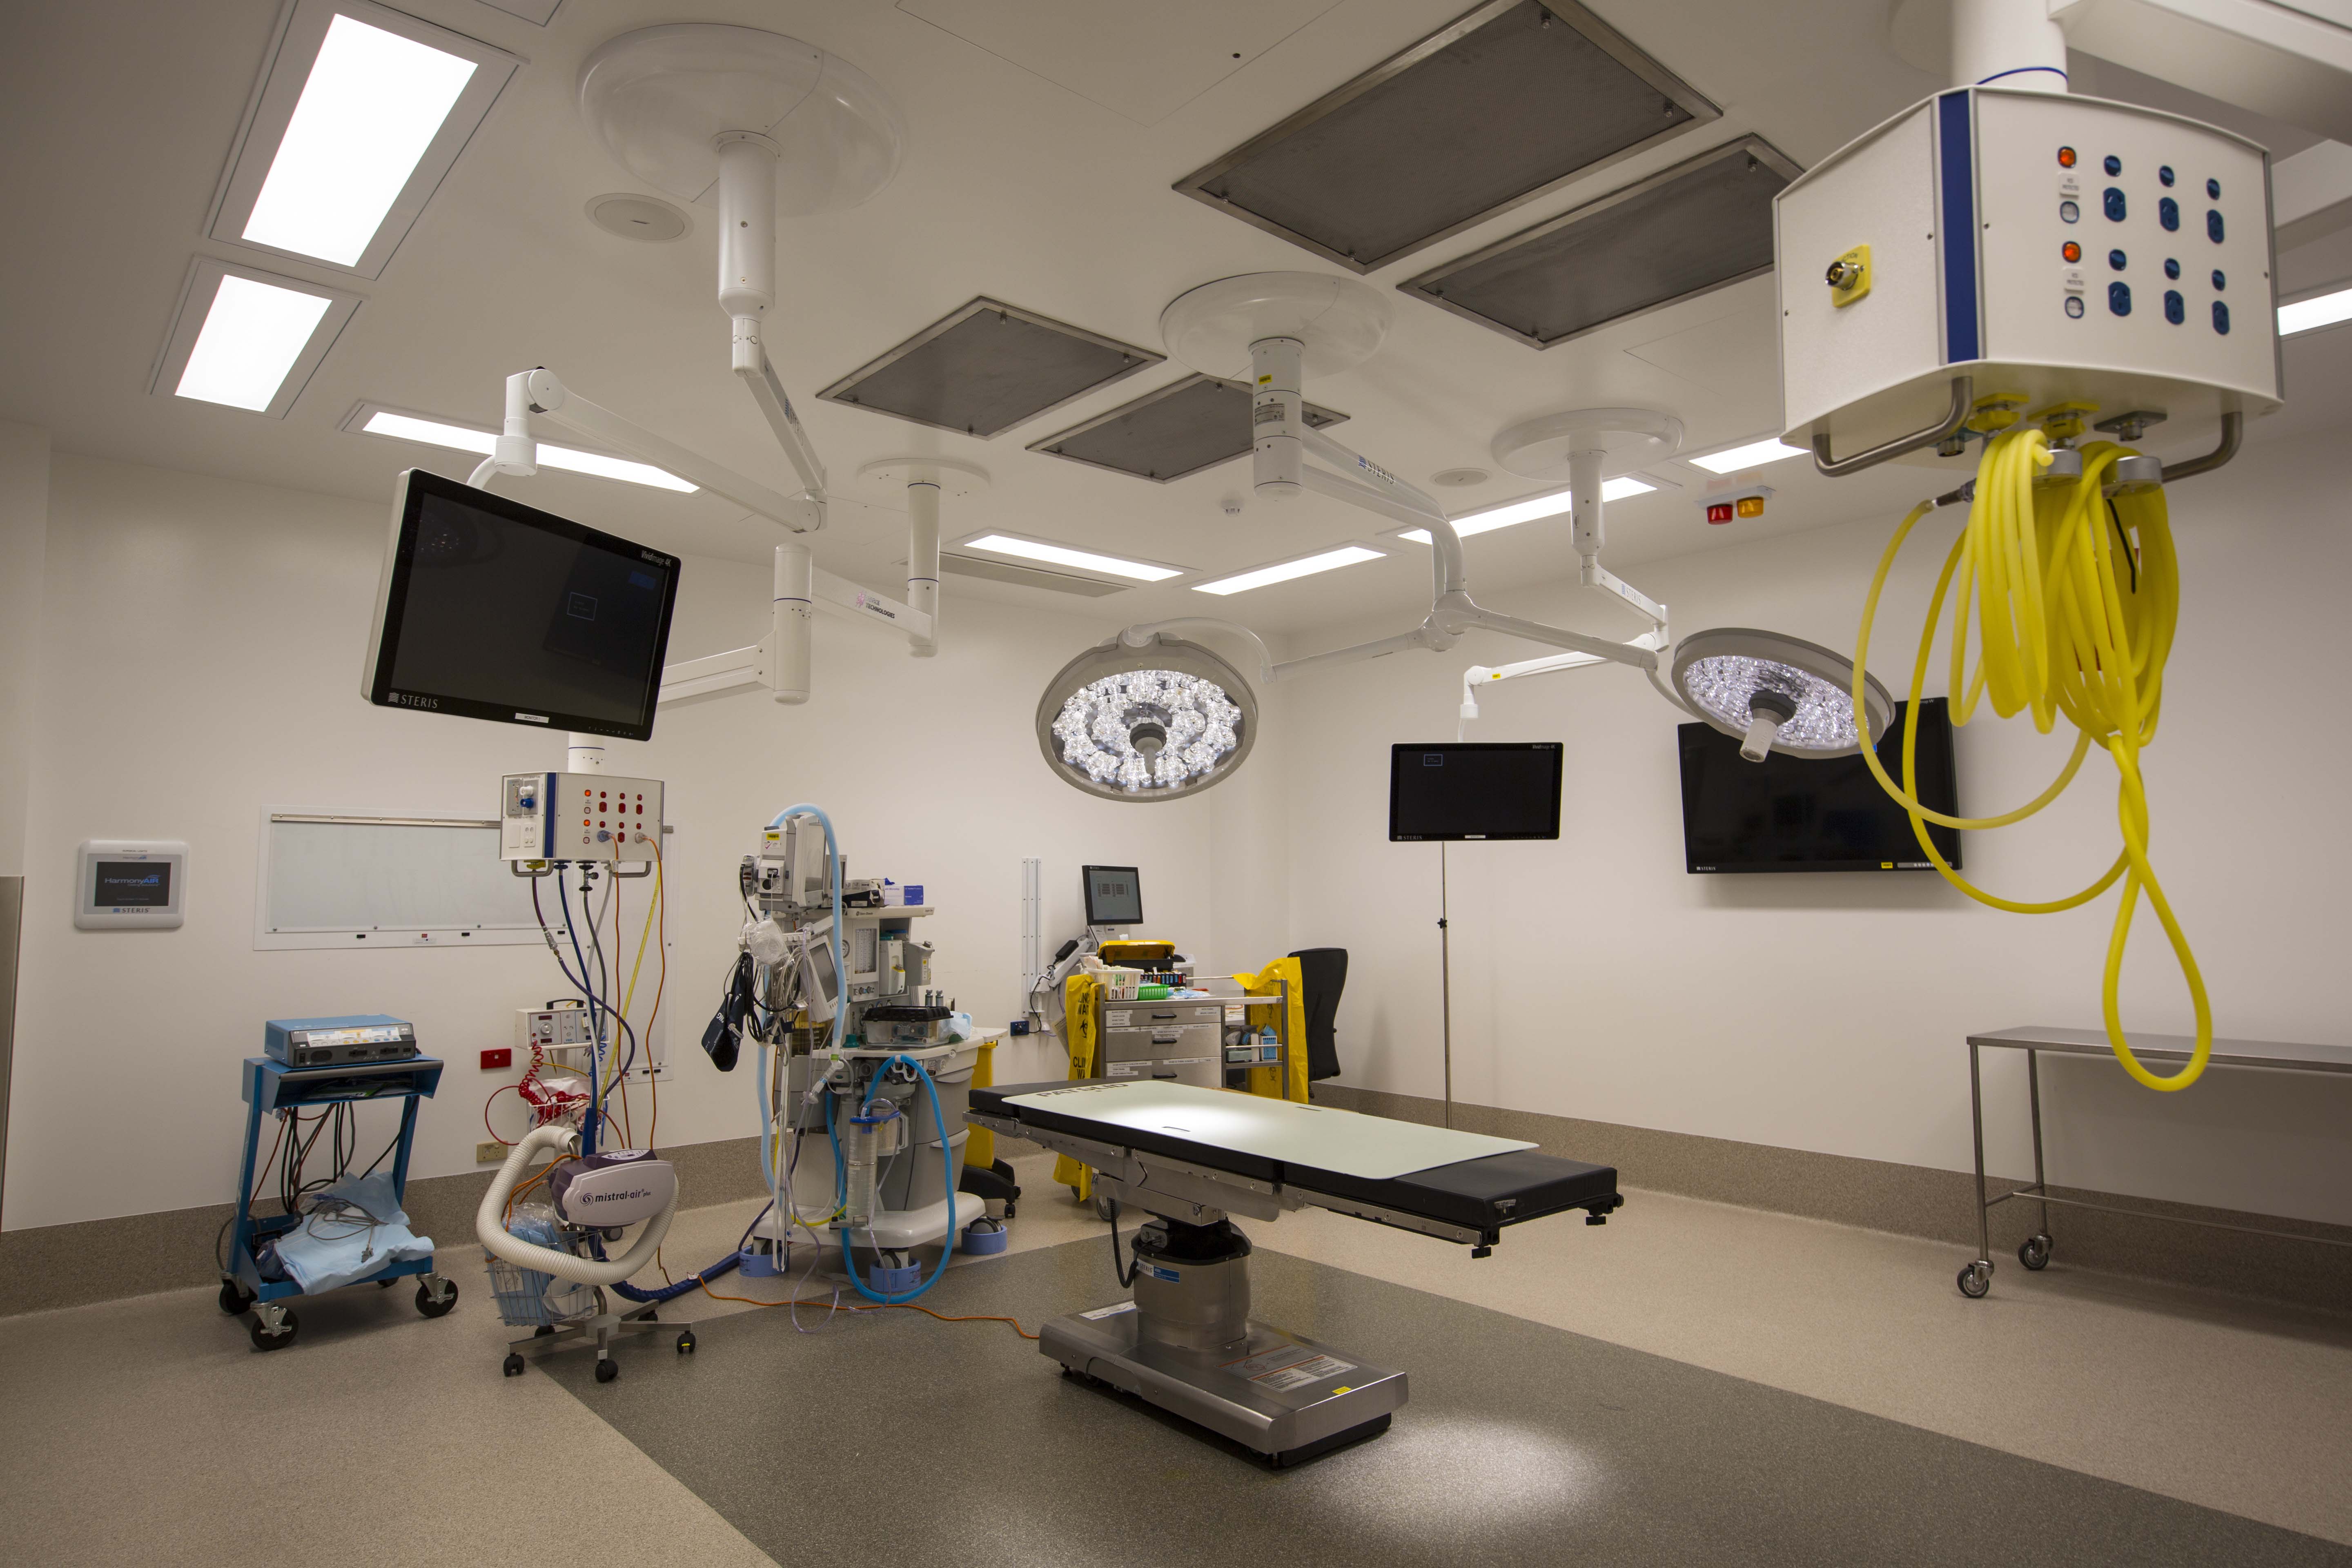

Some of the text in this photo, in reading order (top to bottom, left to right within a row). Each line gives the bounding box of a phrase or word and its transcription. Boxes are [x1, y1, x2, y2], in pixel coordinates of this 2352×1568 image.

[1368, 460, 1395, 484] STERIS
[1627, 588, 1641, 605] STERIS
[866, 603, 895, 619] TECHNOLOGIES
[401, 695, 438, 708] STERIS
[1036, 1084, 1129, 1097] PATSLID
[1140, 1263, 1152, 1273] STERIS
